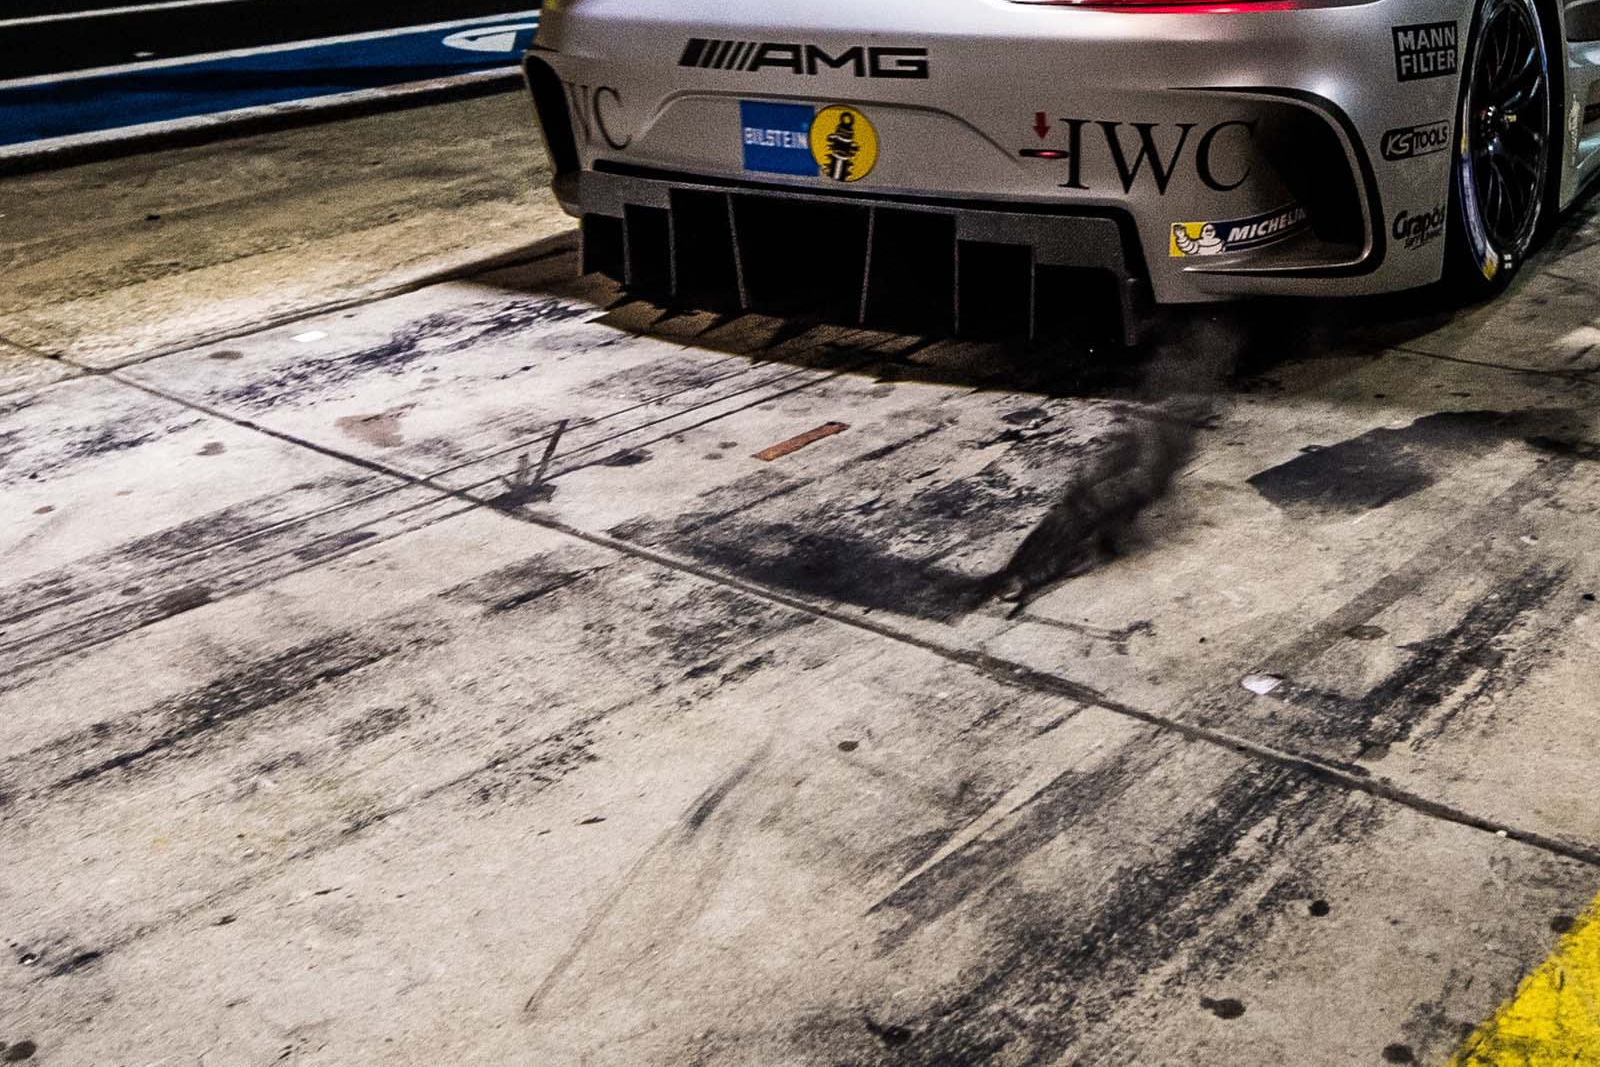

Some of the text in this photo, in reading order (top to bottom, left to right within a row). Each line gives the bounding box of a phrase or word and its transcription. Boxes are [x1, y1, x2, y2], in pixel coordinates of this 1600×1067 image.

[1397, 26, 1456, 52] MANN
[746, 43, 929, 80] AMG
[1401, 49, 1456, 75] FILTER
[744, 127, 809, 149] BILSTEIN
[1058, 118, 1260, 196] IWC
